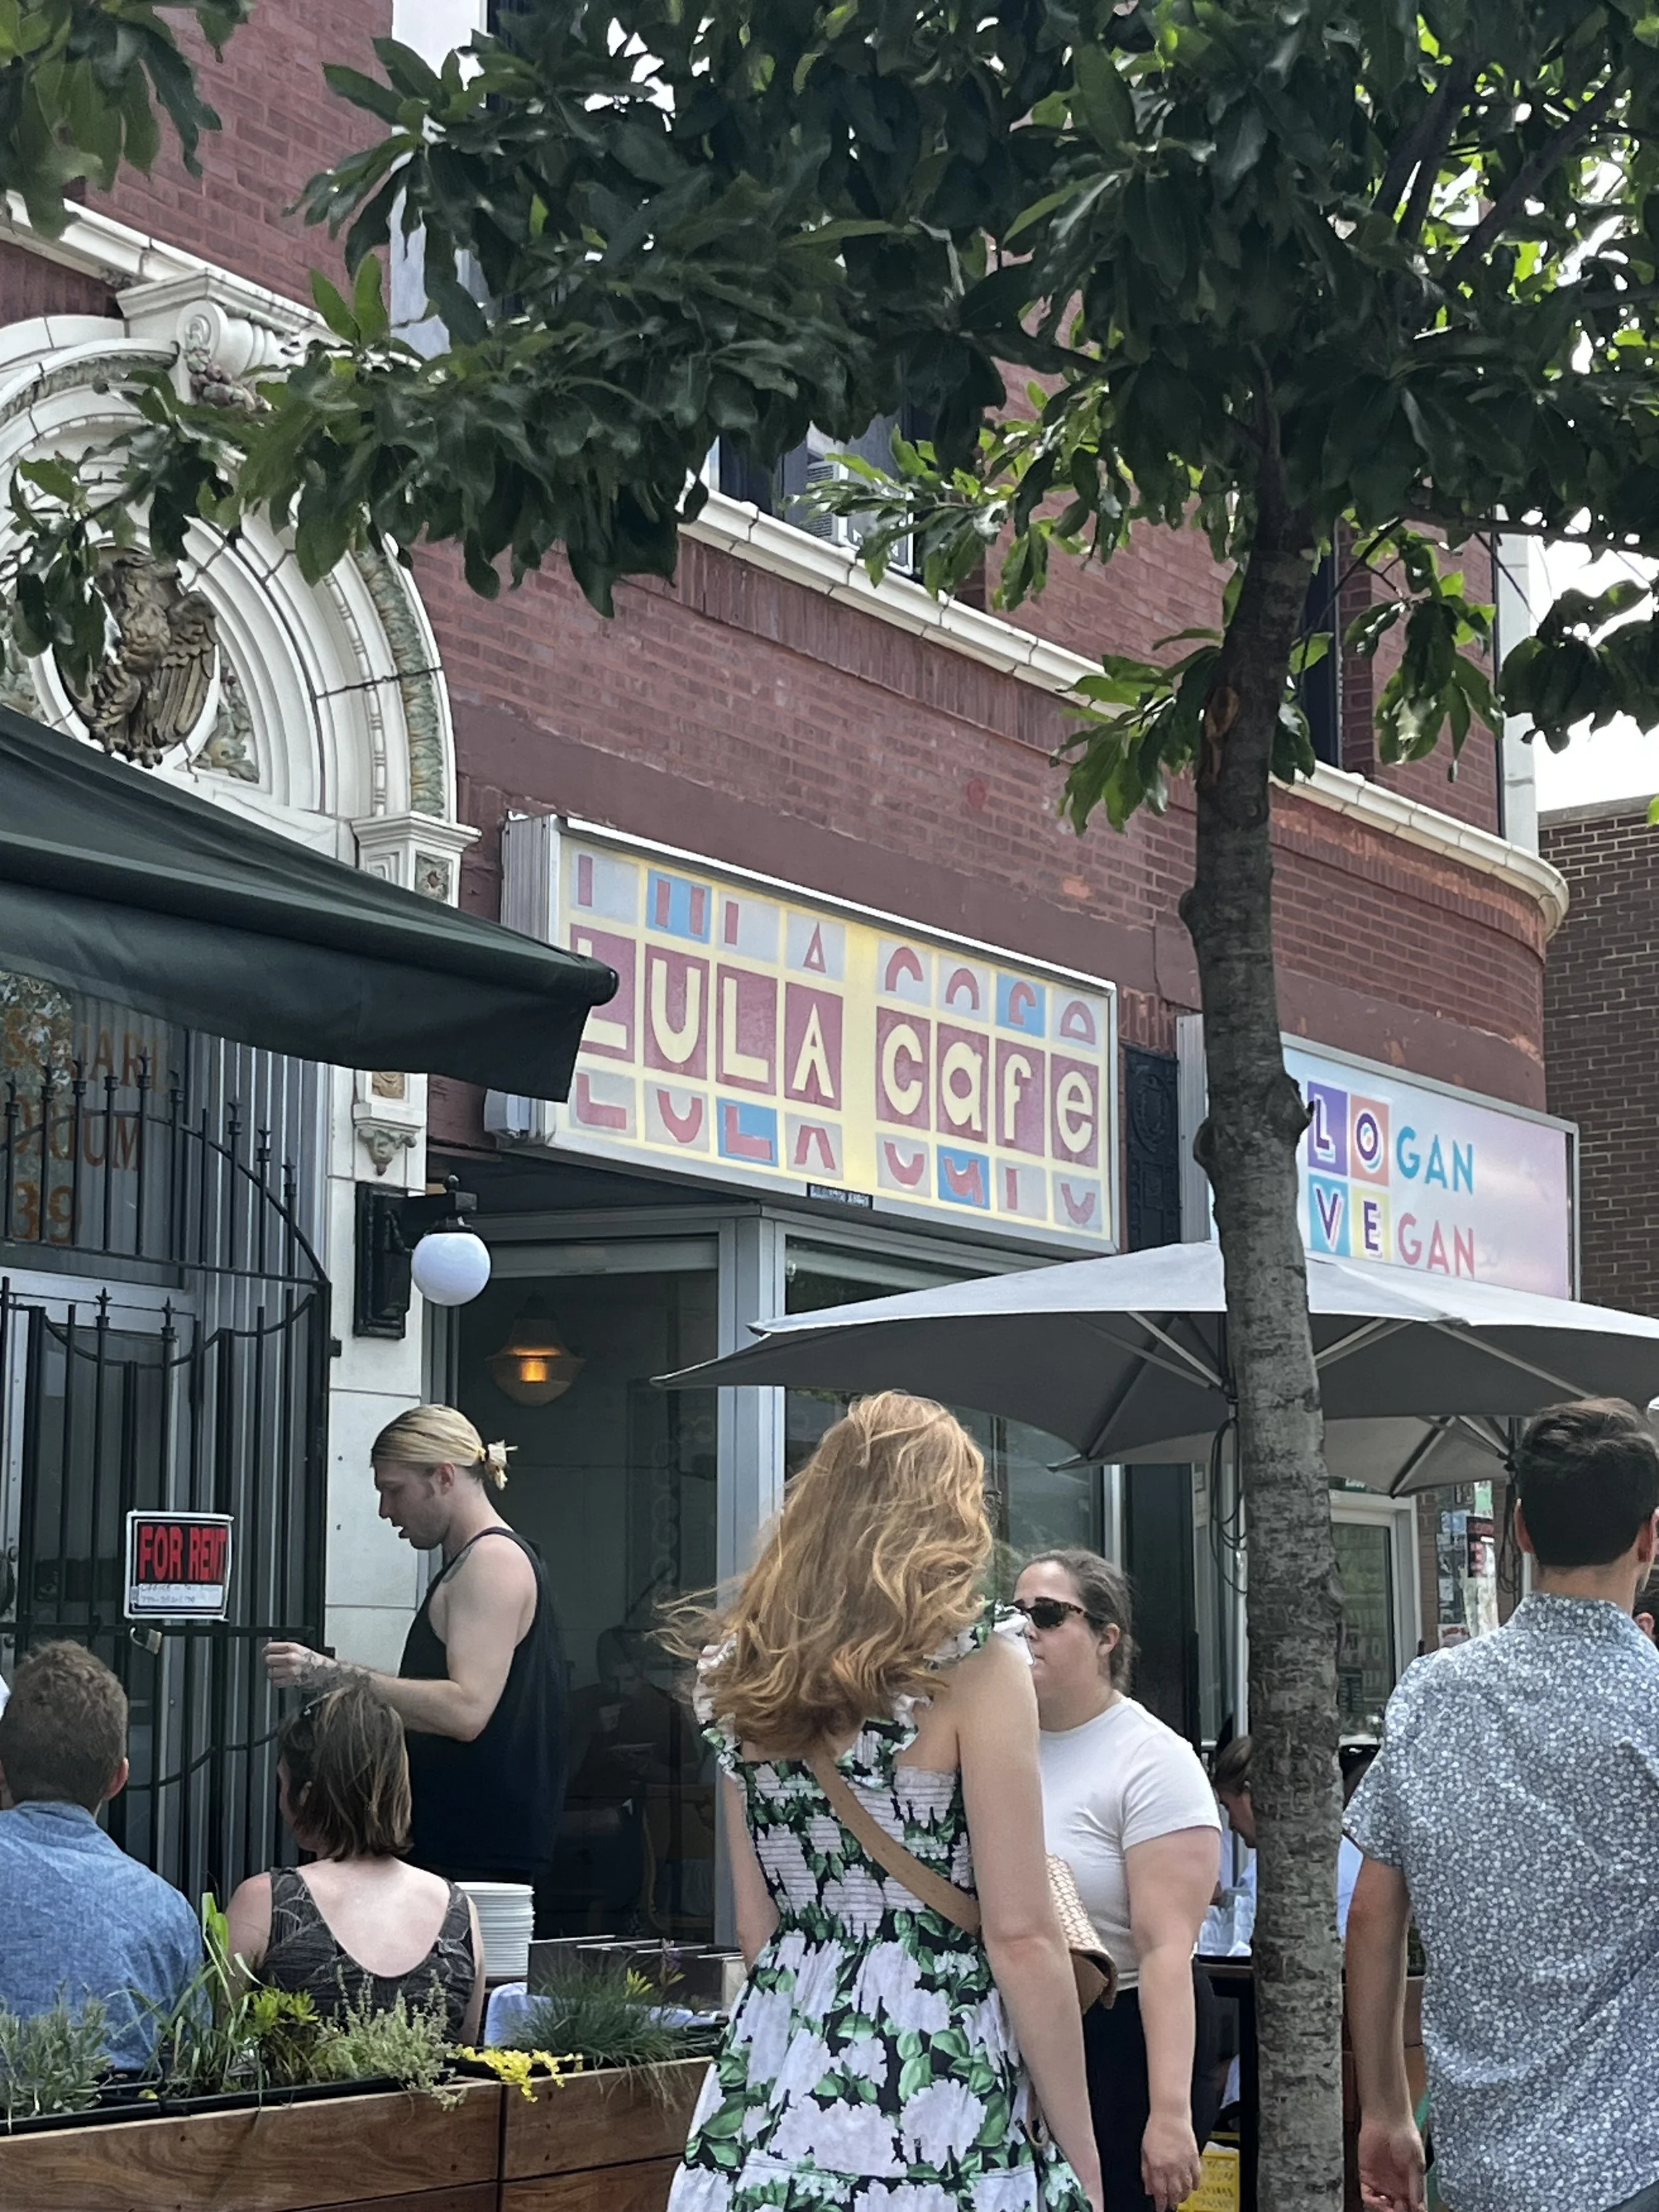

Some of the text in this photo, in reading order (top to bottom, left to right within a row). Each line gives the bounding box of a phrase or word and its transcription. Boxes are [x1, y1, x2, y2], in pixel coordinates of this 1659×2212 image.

[577, 937, 835, 1099] LULA
[882, 1023, 1093, 1153] cafe
[1314, 1094, 1474, 1195] LOGAN
[1315, 1187, 1475, 1280] VEGAN
[139, 1526, 226, 1582] FOR RENT
